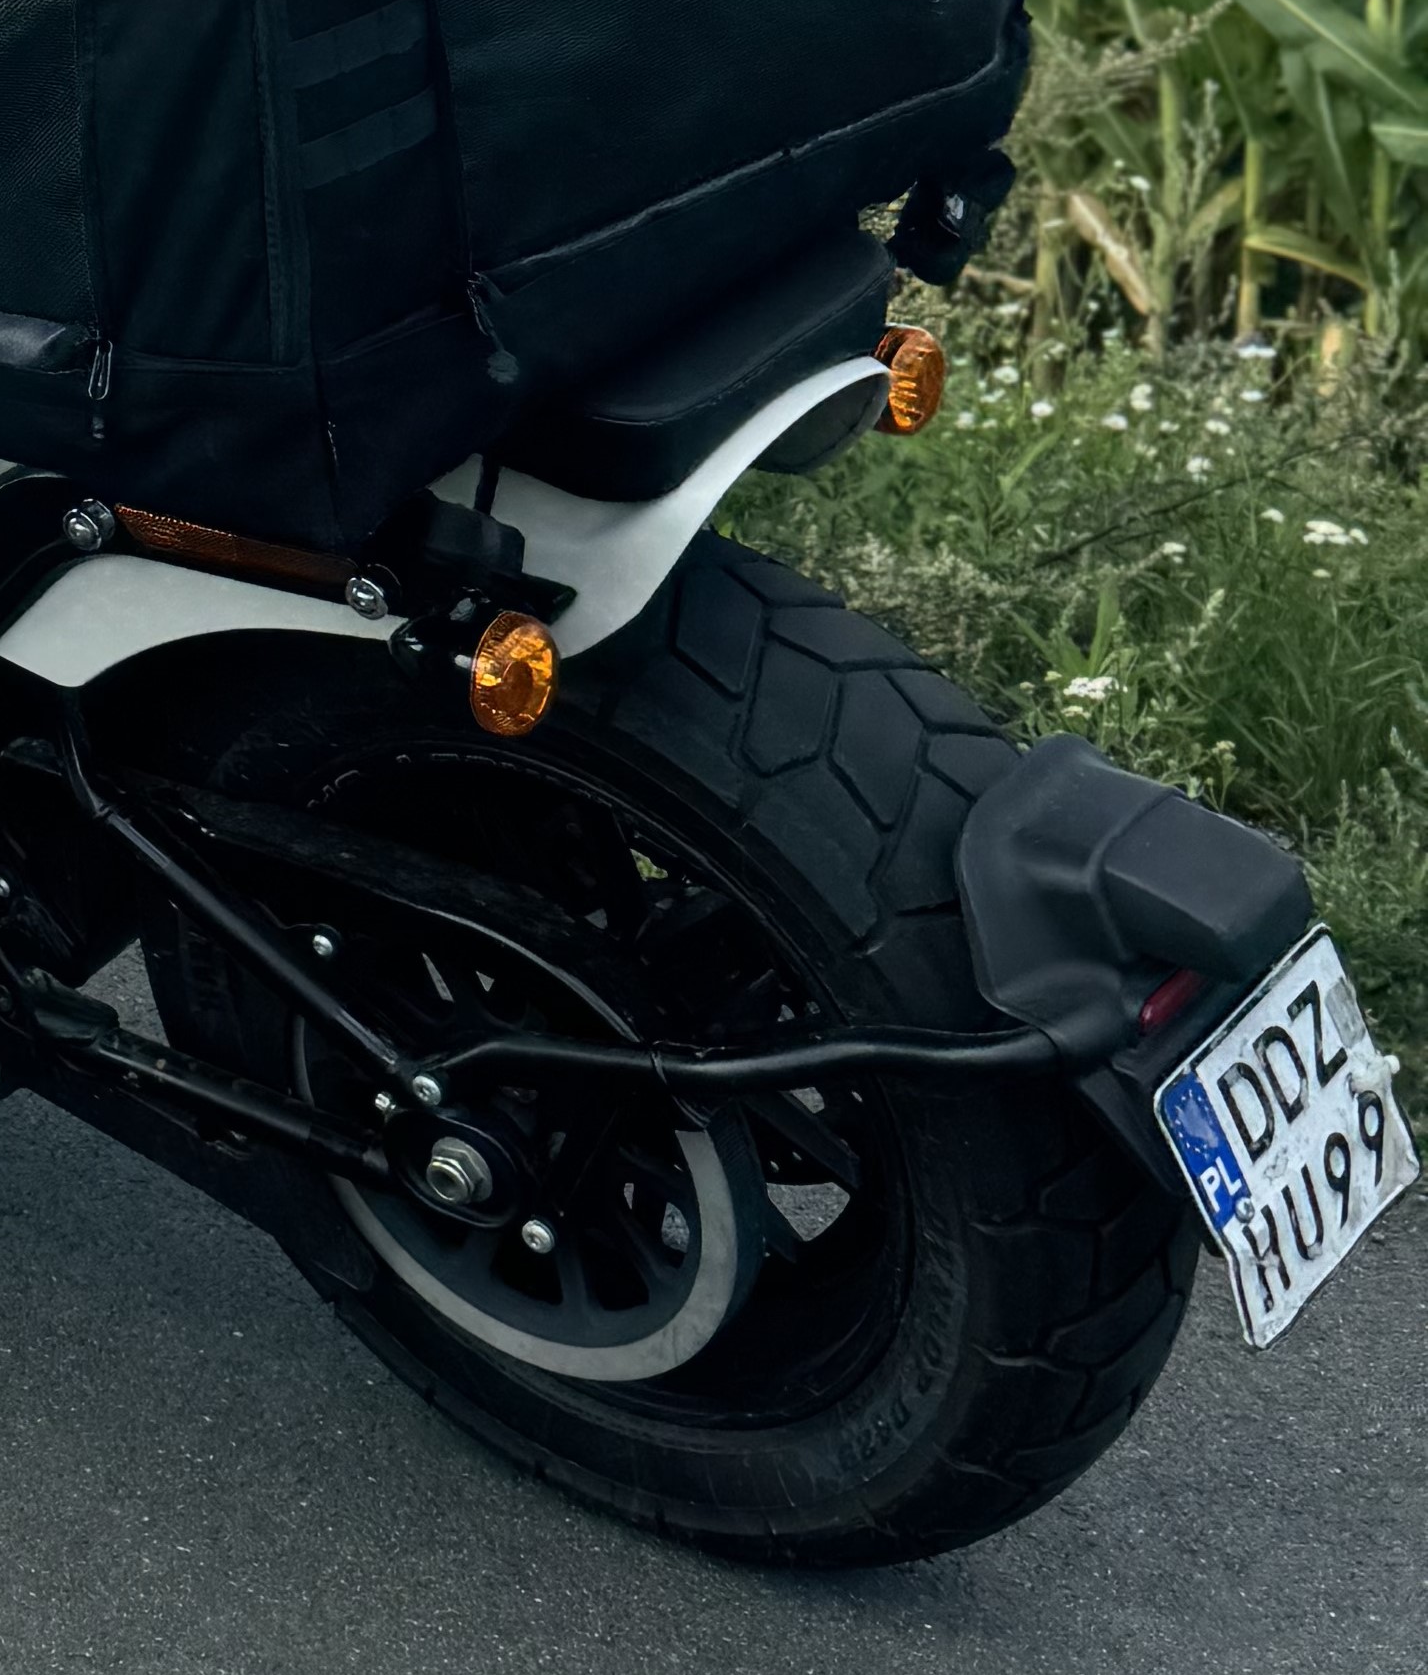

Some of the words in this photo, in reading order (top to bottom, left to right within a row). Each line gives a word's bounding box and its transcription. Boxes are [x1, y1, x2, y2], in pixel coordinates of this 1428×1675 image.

[1216, 980, 1348, 1163] DDZ
[1199, 1156, 1243, 1212] PL
[1243, 1089, 1385, 1313] HU99
